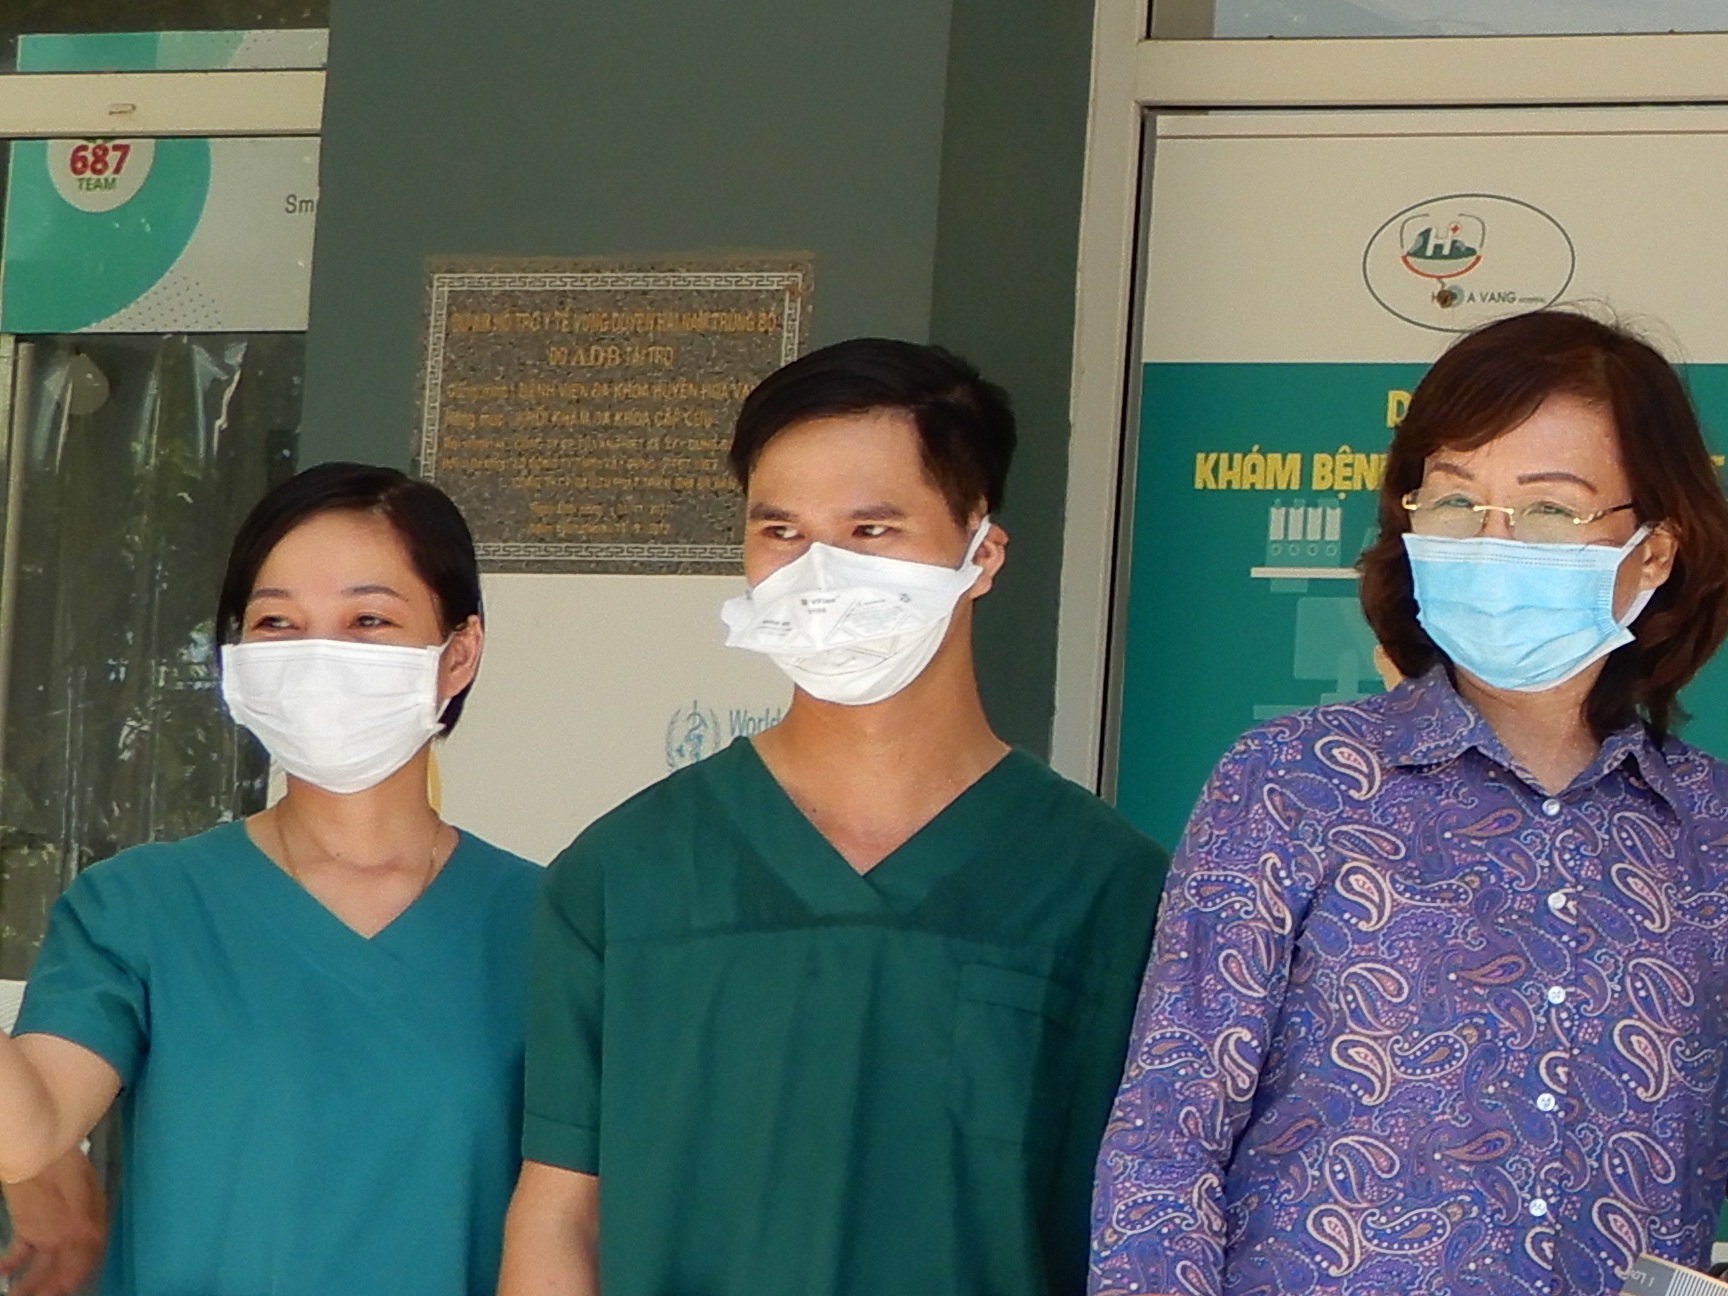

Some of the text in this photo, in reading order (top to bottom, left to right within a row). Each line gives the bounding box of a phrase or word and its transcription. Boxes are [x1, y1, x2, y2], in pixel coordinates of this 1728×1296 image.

[69, 144, 132, 176] 687
[76, 177, 117, 192] TEAM
[1480, 291, 1517, 304] VANG
[1194, 444, 1302, 491] KHÁM
[729, 707, 782, 738] World
